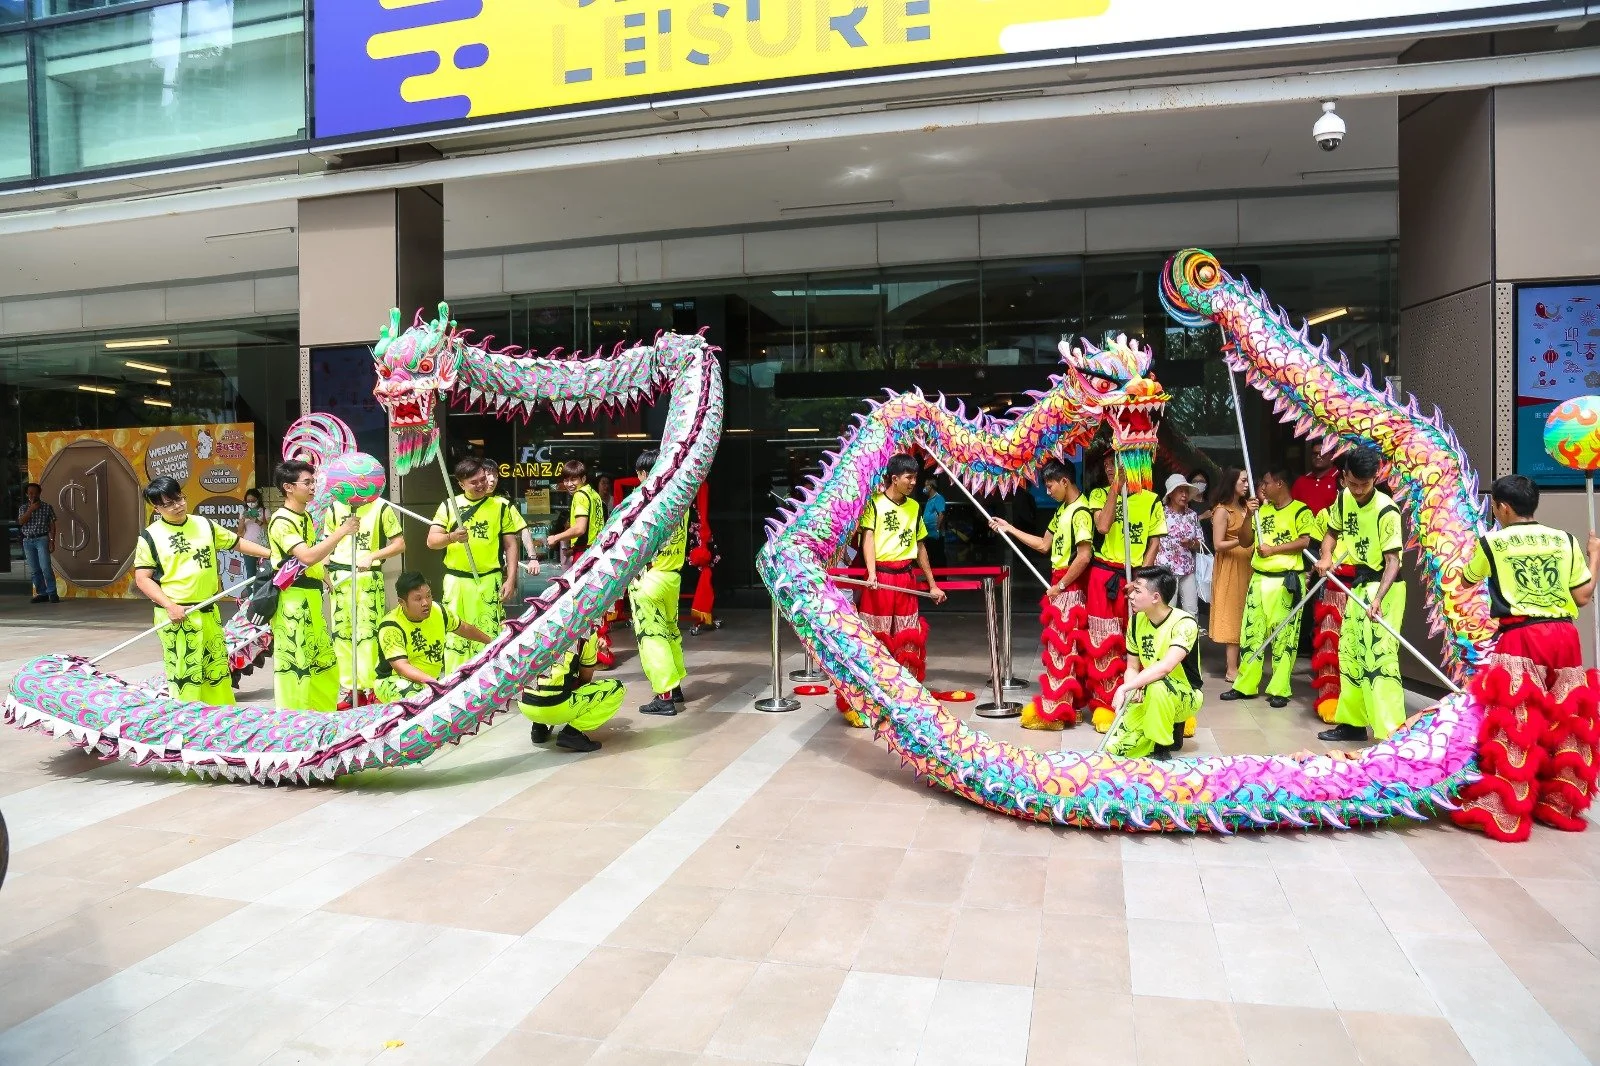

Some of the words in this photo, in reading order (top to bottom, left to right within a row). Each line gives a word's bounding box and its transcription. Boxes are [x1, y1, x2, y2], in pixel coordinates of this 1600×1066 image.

[552, 0, 932, 86] LEISURE
[148, 441, 187, 458] WEEKDAY
[520, 446, 551, 463] FC
[155, 460, 188, 475] 3-HOUR
[58, 459, 119, 564] $1
[199, 505, 216, 515] PER
